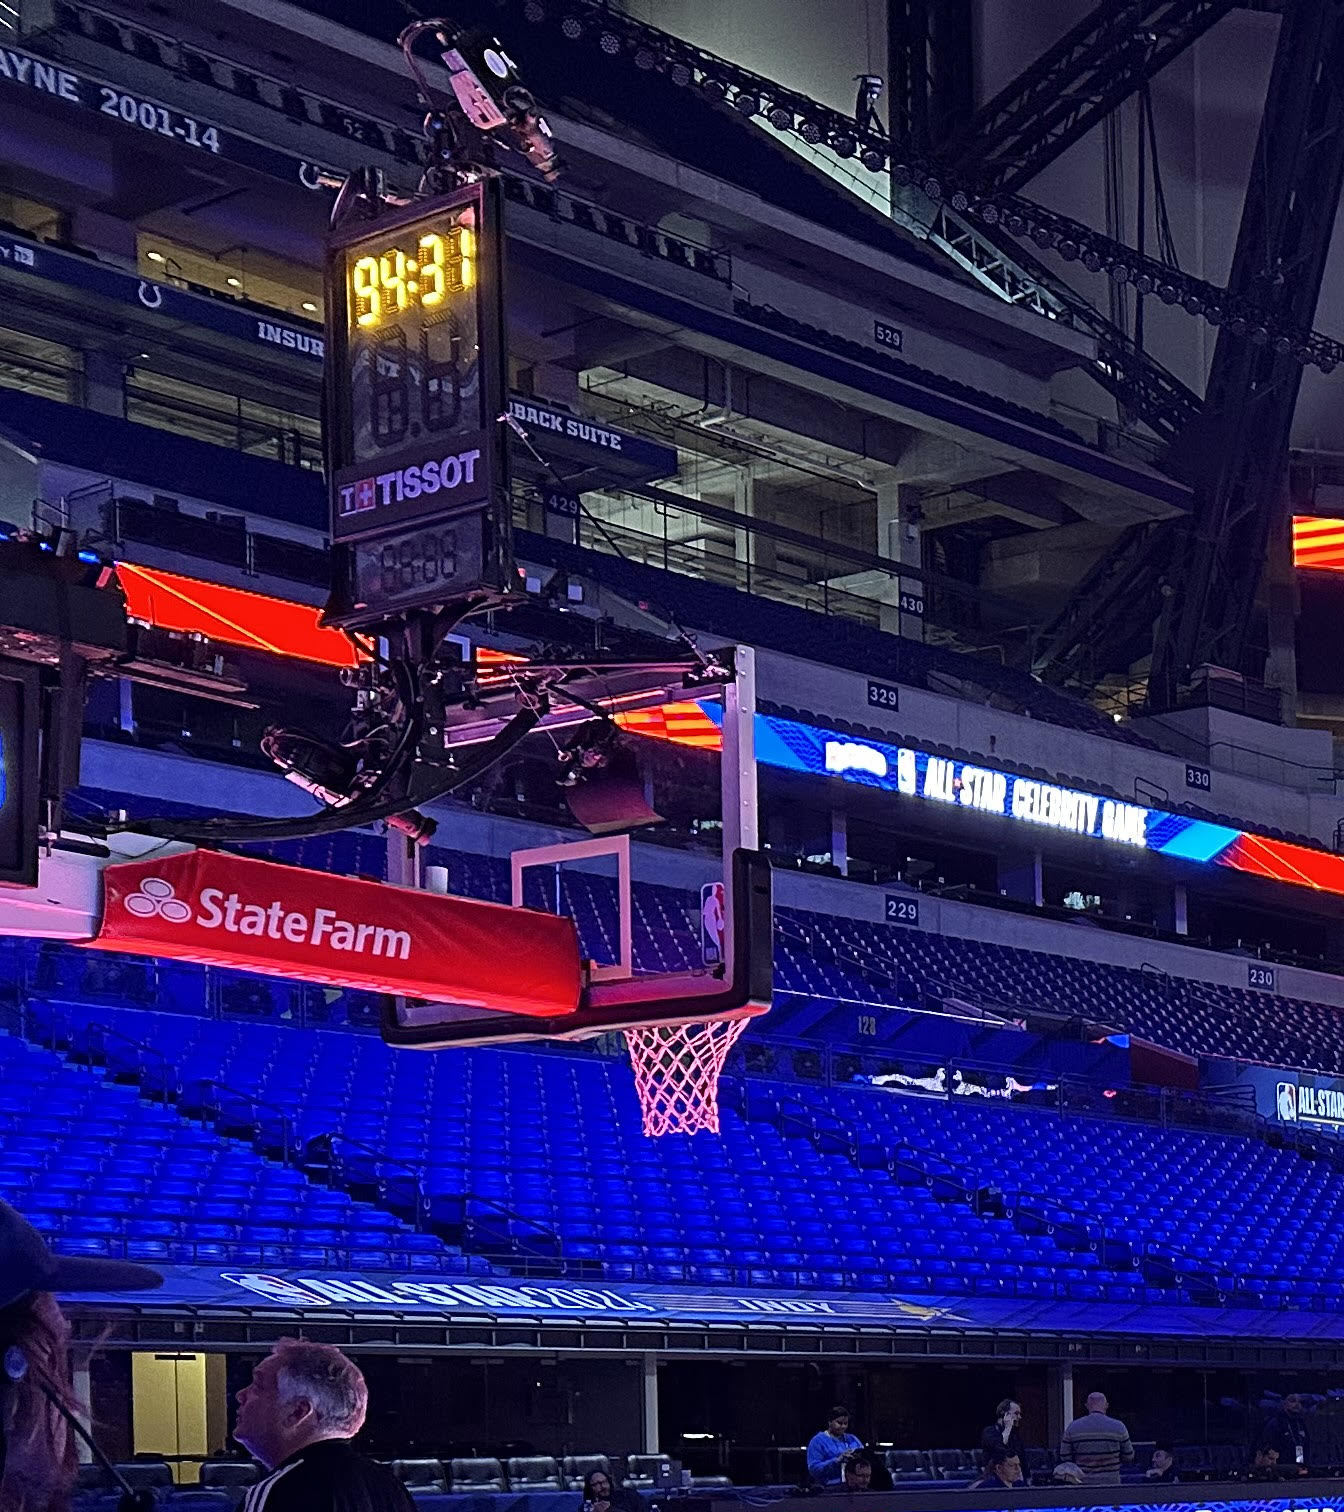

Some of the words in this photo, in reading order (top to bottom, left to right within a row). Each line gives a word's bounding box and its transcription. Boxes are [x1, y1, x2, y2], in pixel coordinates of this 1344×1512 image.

[100, 87, 220, 153] 2001-14
[353, 226, 477, 327] 94:31
[876, 323, 901, 346] 529
[566, 420, 622, 451] SUITE
[376, 449, 481, 506] TISSOT
[548, 495, 578, 513] 429
[900, 597, 924, 614] 430
[869, 686, 897, 706] 329
[1186, 769, 1210, 787] 330
[887, 901, 917, 920] 229
[1249, 969, 1273, 986] 230
[522, 1287, 656, 1312] 2024
[737, 1299, 836, 1314] INDY
